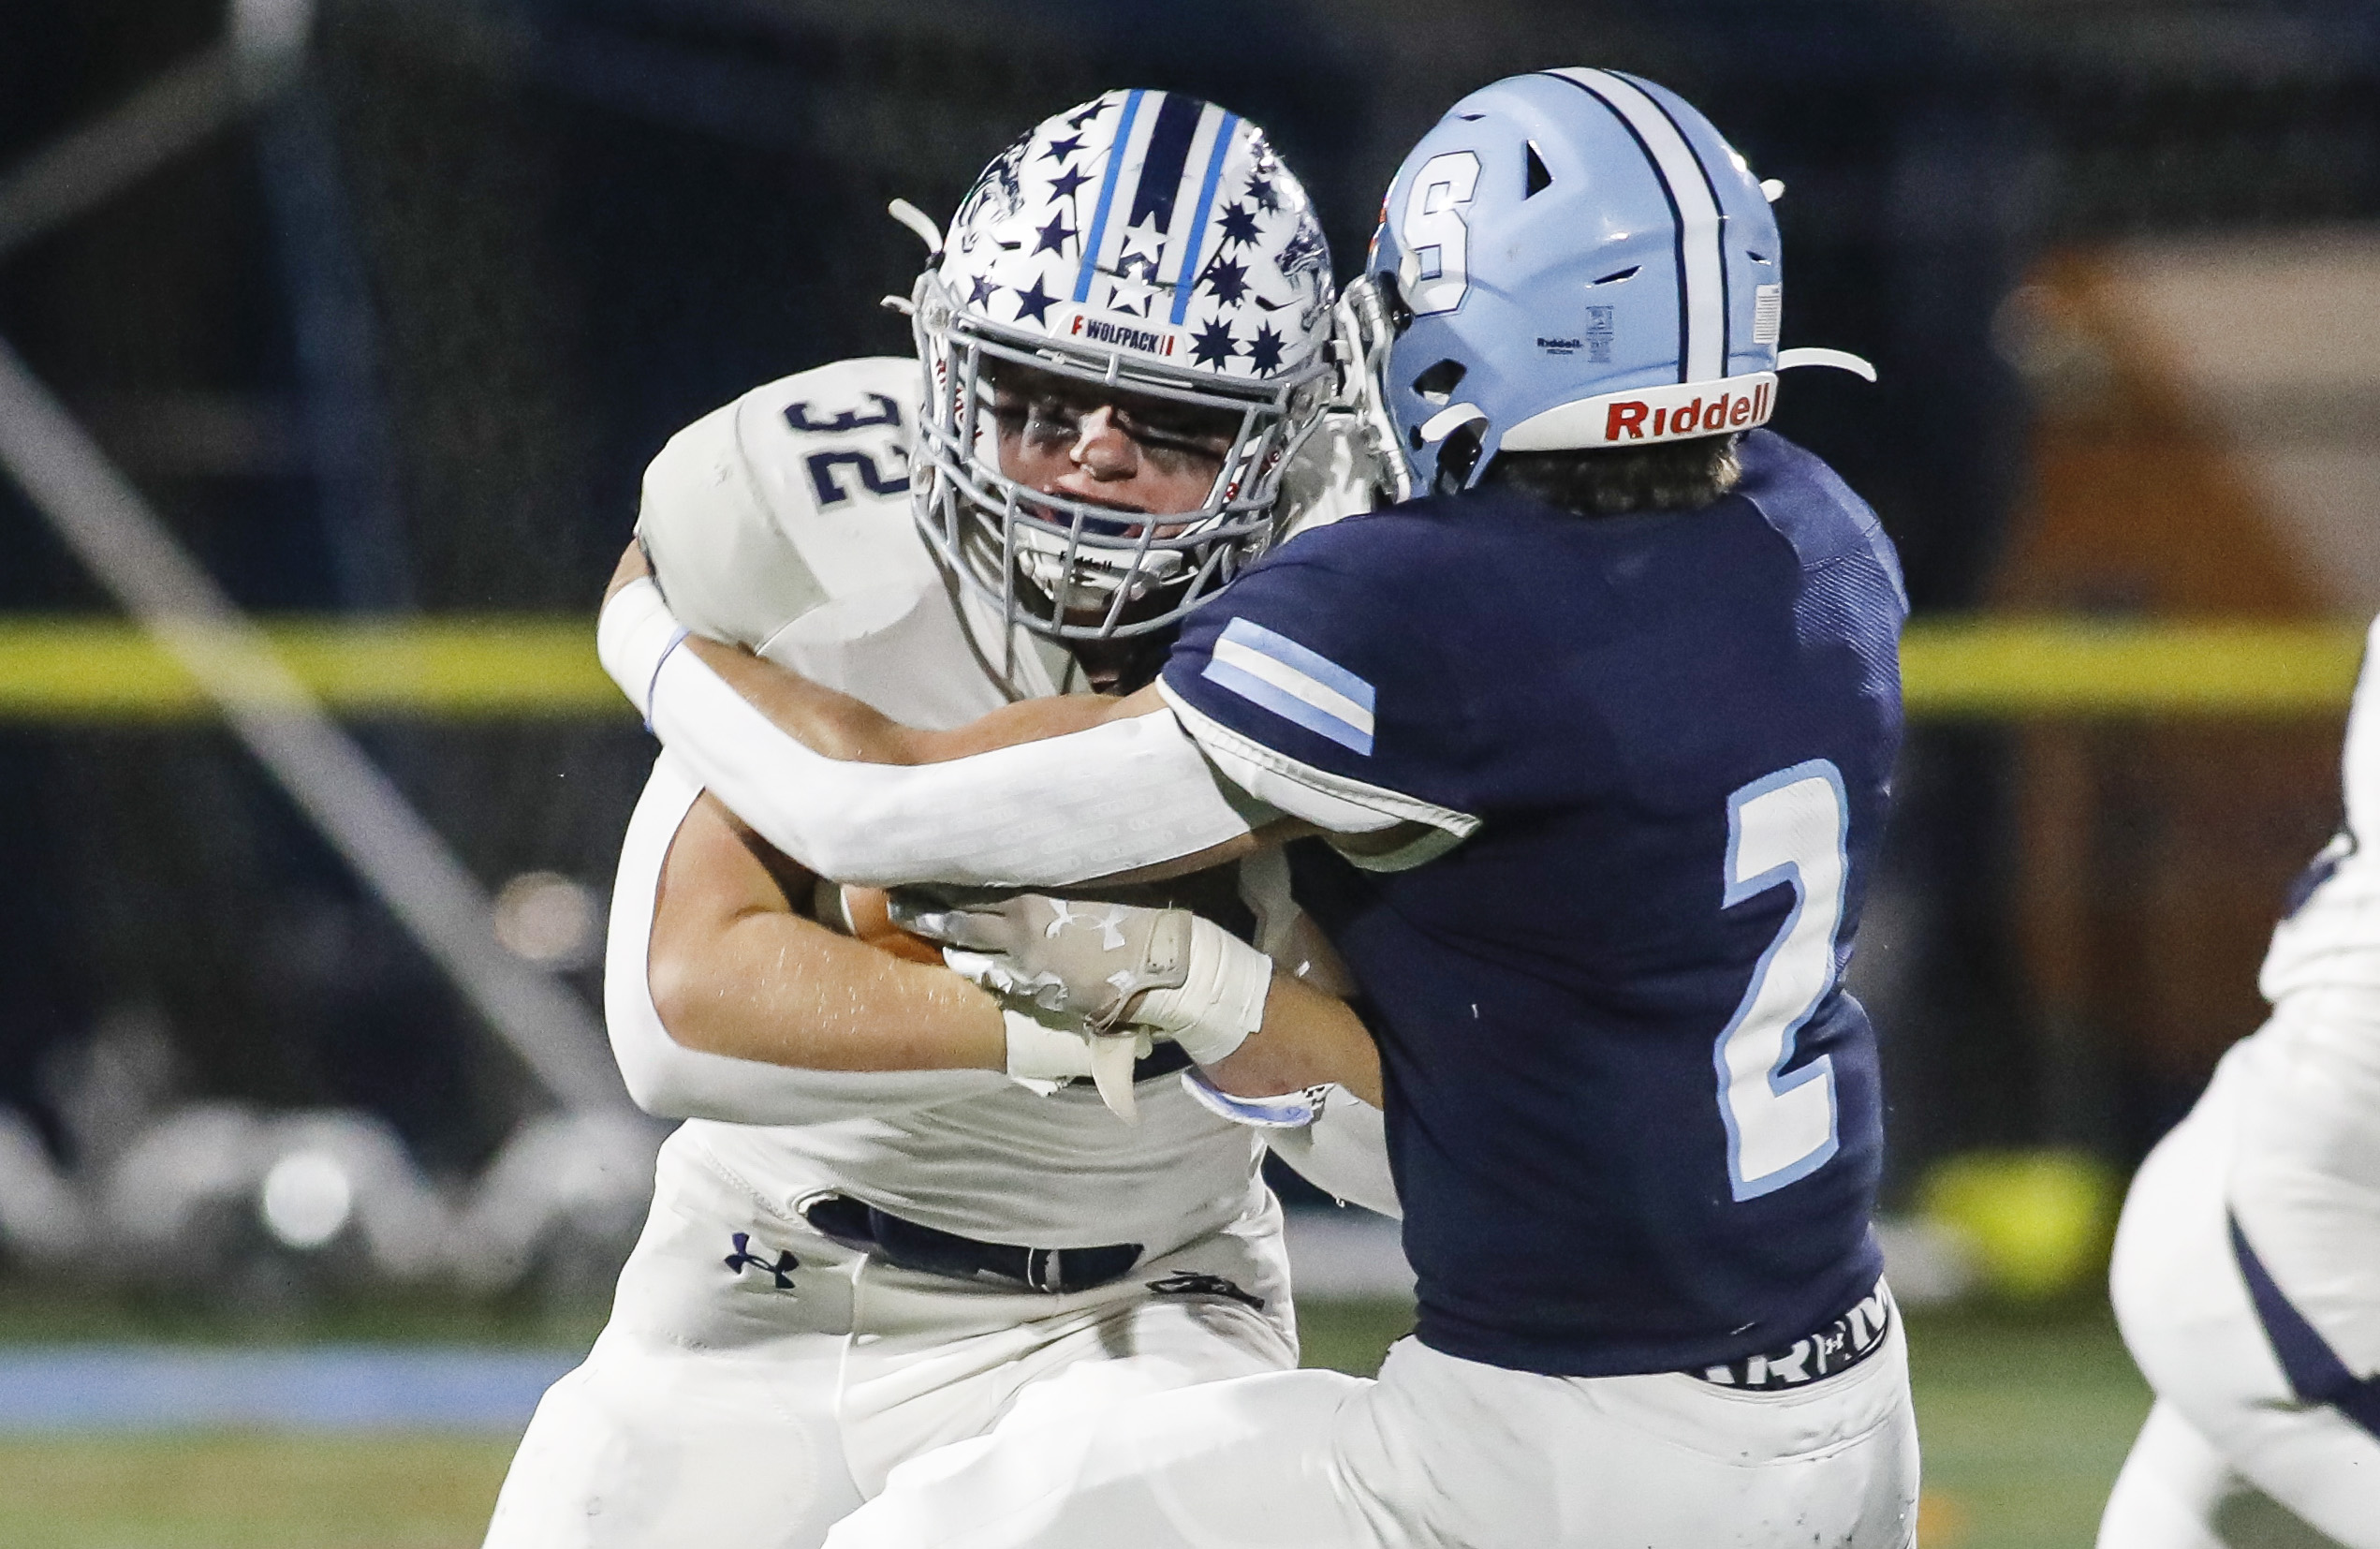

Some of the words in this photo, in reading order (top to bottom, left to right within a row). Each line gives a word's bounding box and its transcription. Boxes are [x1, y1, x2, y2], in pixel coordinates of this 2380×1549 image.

[1398, 150, 1482, 317] S
[1086, 319, 1159, 353] WOLFPACK
[781, 391, 912, 509] 32
[1605, 382, 1770, 442] Riddell
[1713, 758, 1849, 1202] 2
